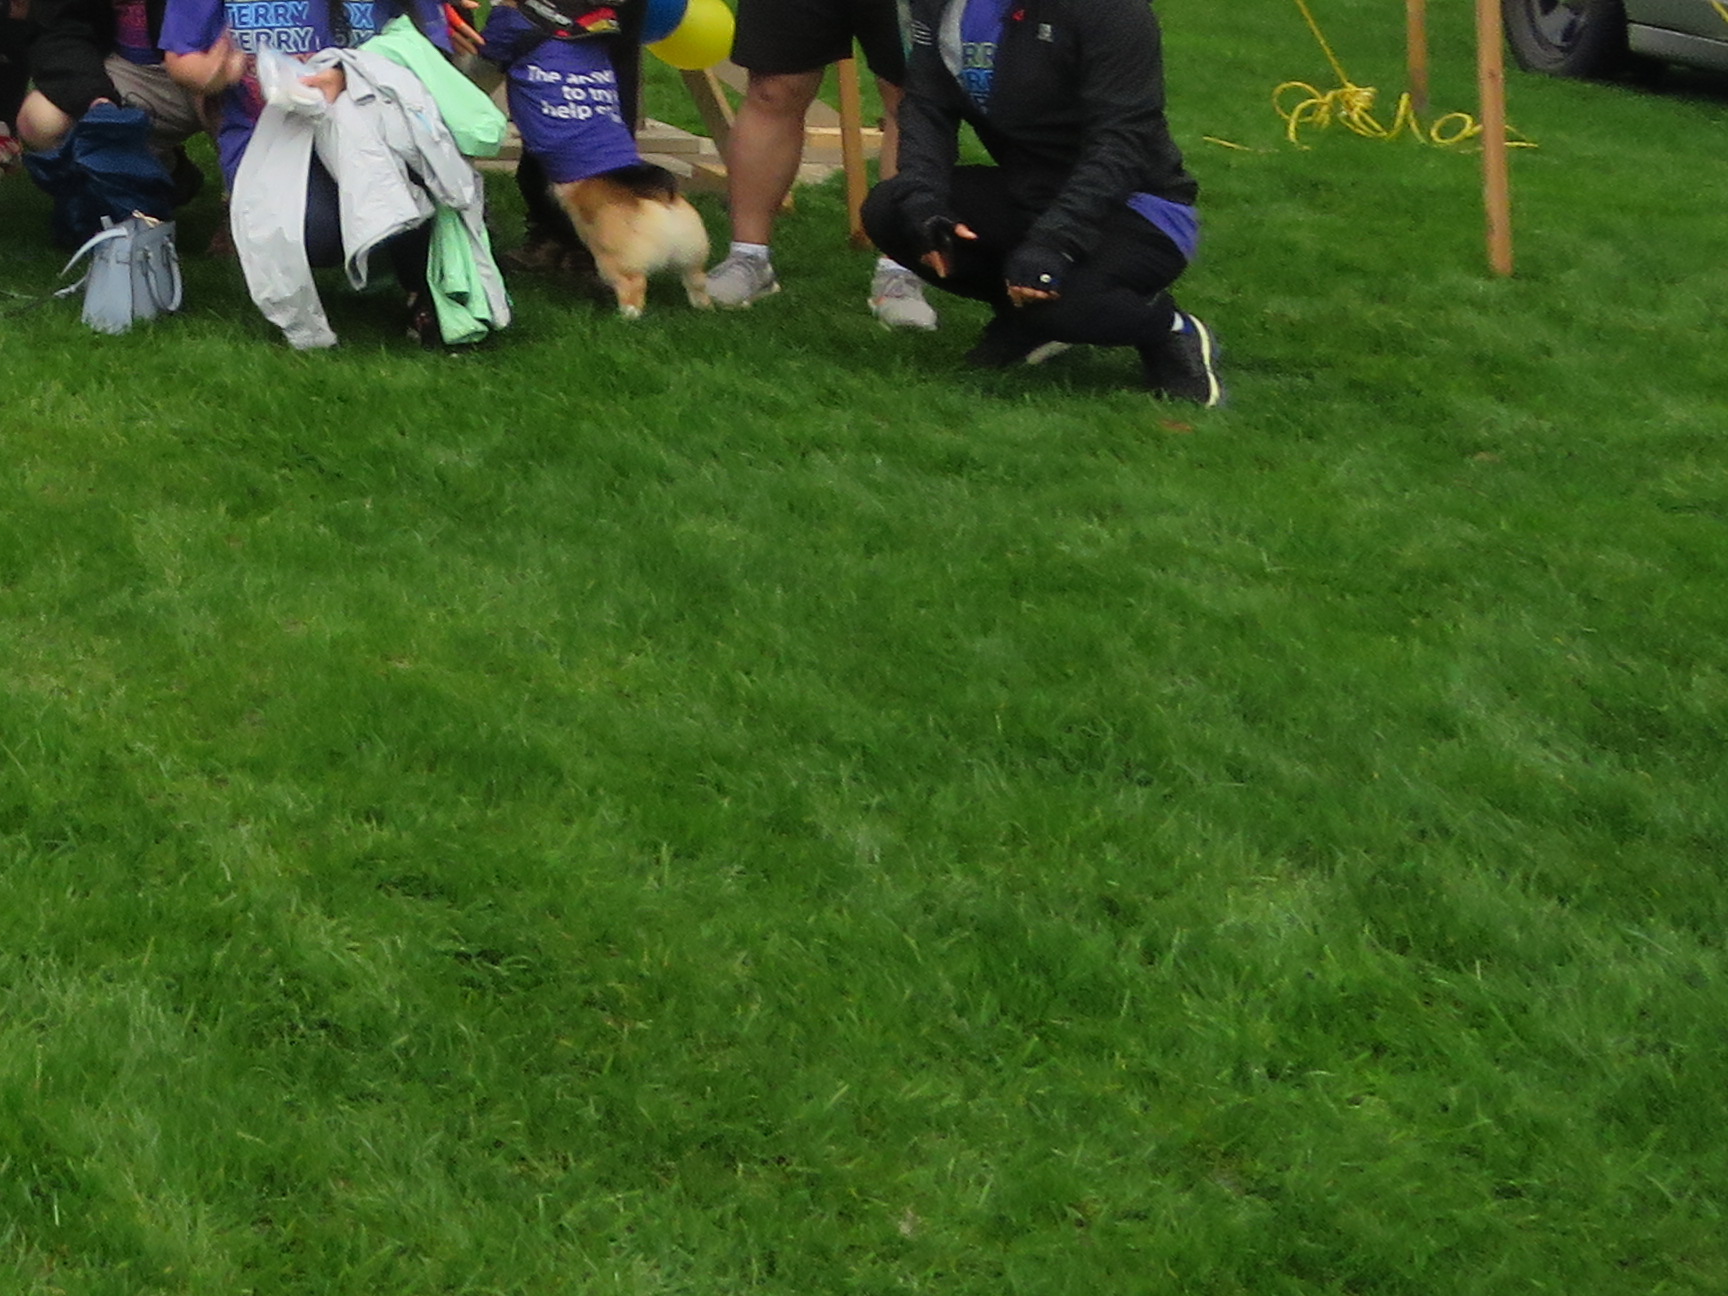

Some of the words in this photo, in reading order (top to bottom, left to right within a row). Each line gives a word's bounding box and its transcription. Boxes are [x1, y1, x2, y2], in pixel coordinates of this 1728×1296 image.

[527, 64, 563, 84] The
[561, 85, 587, 101] to
[540, 99, 593, 121] help
